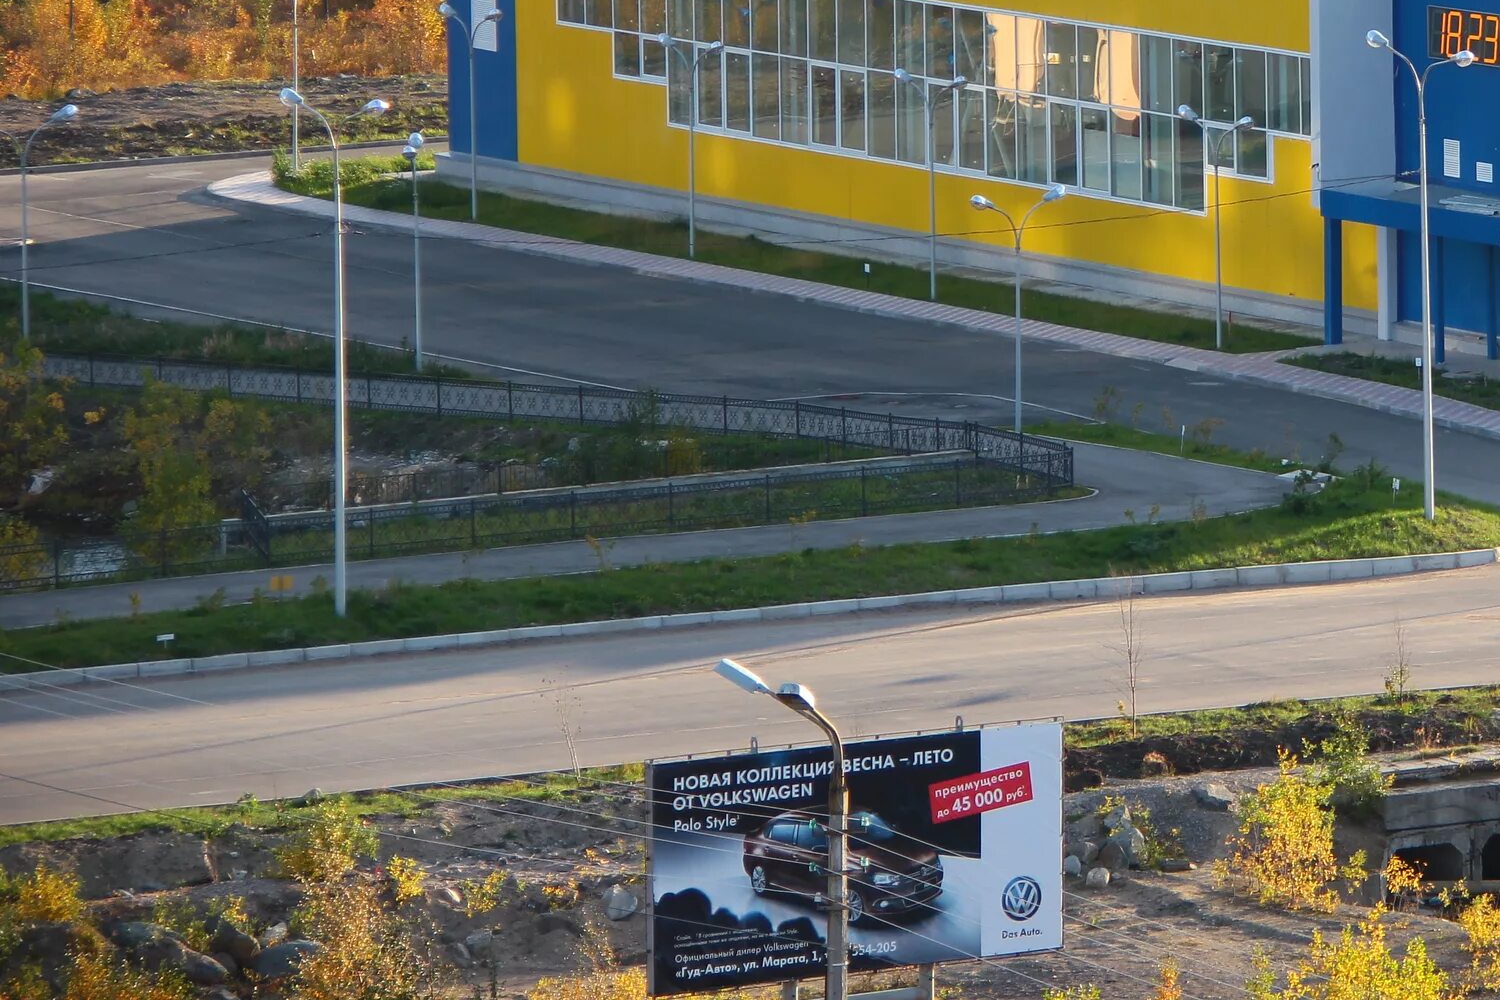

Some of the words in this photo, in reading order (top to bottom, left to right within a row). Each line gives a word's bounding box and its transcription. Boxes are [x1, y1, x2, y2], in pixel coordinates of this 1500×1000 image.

[673, 771, 731, 792] НОВАЯ
[736, 760, 835, 785] КОЛЛЕКЦИЯ
[842, 754, 895, 773] ВЕСНА
[912, 748, 954, 766] ЛЕТО
[935, 769, 1024, 799] преимущество
[673, 796, 694, 811] ОТ
[700, 783, 813, 808] VOLKSWAGEN
[937, 808, 950, 819] до
[952, 796, 971, 813] 45
[975, 788, 1003, 808] 000
[674, 817, 702, 832] Polo
[1002, 930, 1018, 939] Das
[1020, 928, 1043, 937] Auto.
[674, 948, 734, 964] Официальный
[735, 947, 761, 957] дилер
[763, 940, 809, 952] Volkswagen
[675, 962, 740, 980] «Гуд-Авто»,
[743, 962, 759, 974] ул.
[762, 953, 809, 969] Марата,
[811, 951, 822, 963] 1,
